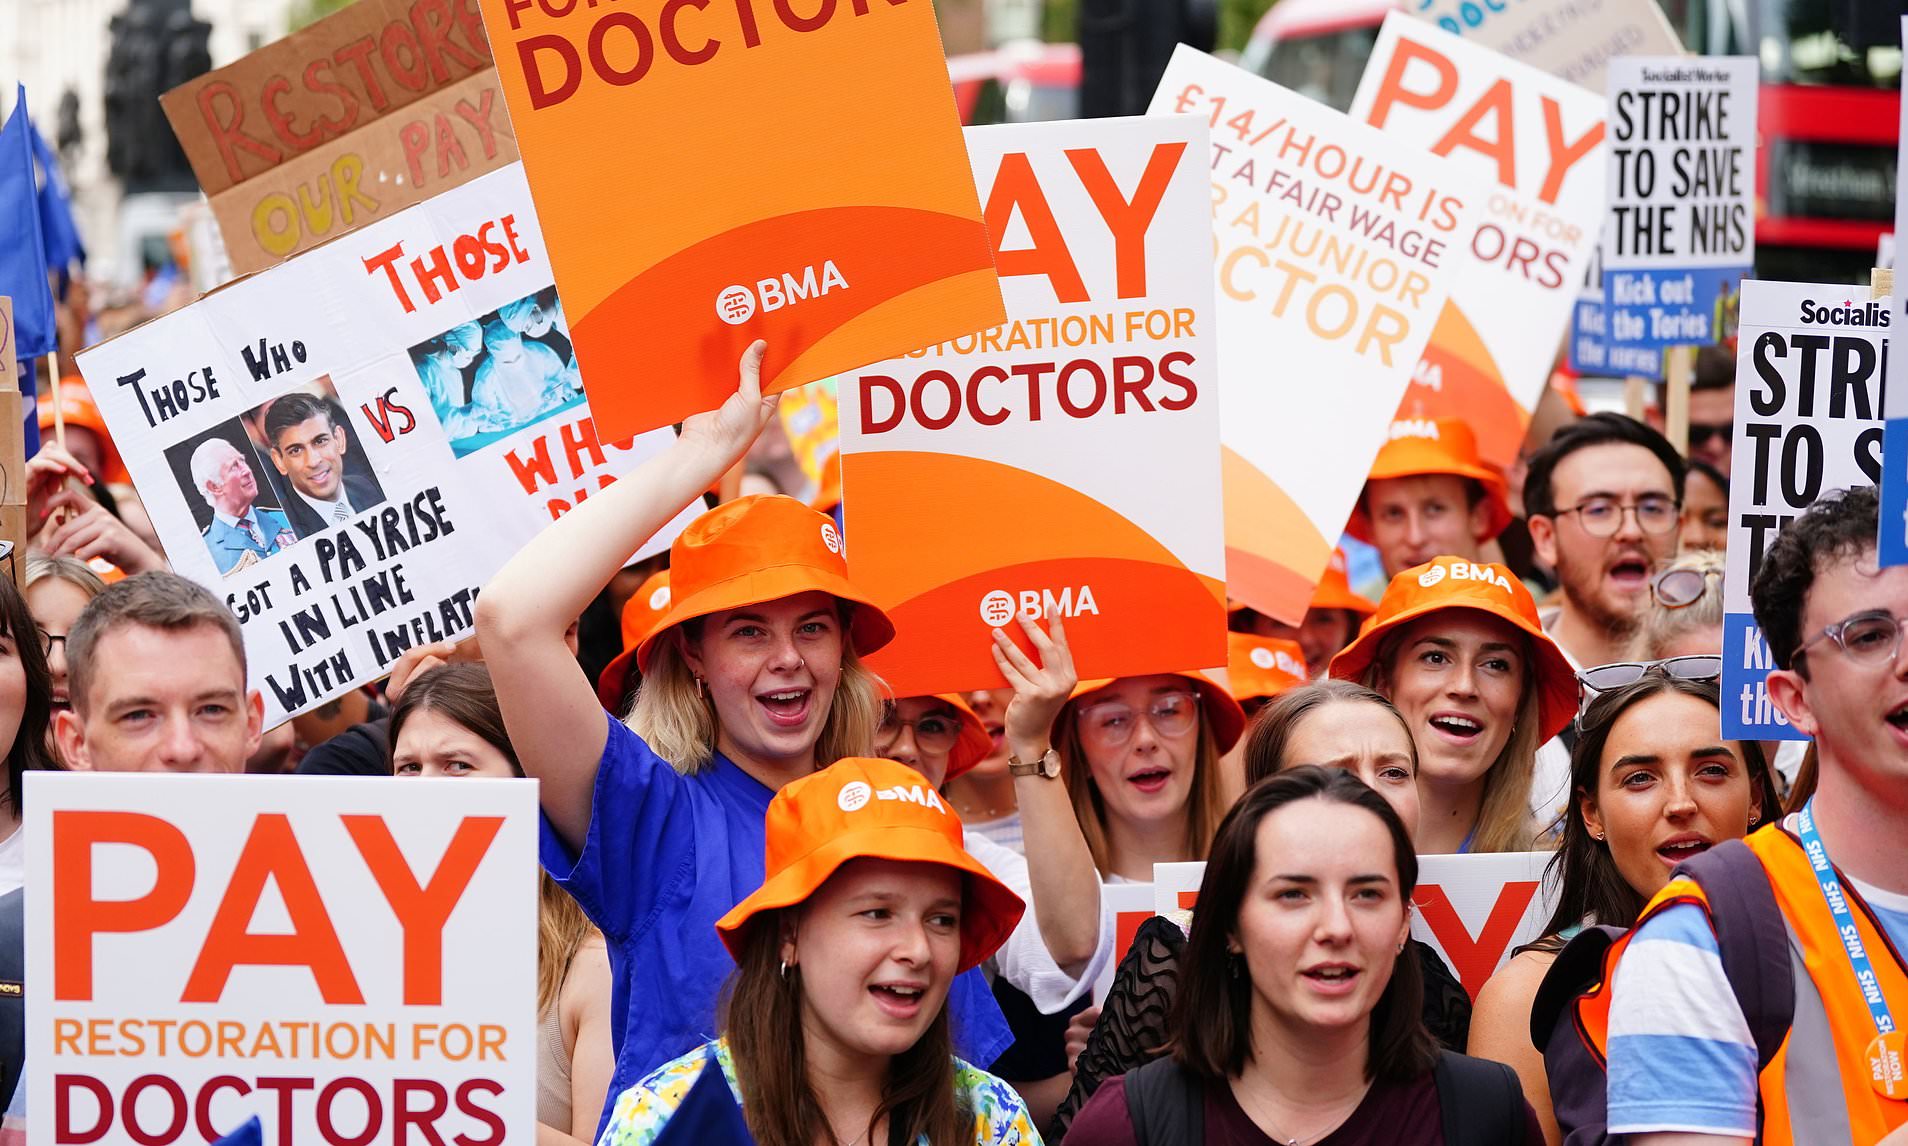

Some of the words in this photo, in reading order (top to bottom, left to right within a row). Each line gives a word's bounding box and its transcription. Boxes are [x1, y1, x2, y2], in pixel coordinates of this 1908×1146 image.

[1366, 36, 1606, 206] PAY
[1615, 91, 1731, 141] STRIKE
[251, 152, 380, 257] OUR
[400, 88, 498, 189] PAY
[1174, 84, 1413, 212] £14/HOUR
[1418, 190, 1464, 233] IS
[1614, 149, 1656, 199] TO
[1672, 148, 1742, 199] SAVE
[983, 141, 1188, 303] AY
[1232, 158, 1256, 187] A
[1265, 170, 1342, 222] FAIR
[1349, 204, 1447, 268] WAGE
[1612, 206, 1676, 256] THE
[1691, 203, 1747, 253] NHS
[362, 214, 530, 314] THOSE
[1231, 201, 1261, 237] A
[1264, 215, 1431, 309] JUNIOR
[756, 260, 849, 313] BMA
[1212, 231, 1412, 367] CTOR
[1613, 273, 1656, 305] Kick
[1660, 273, 1694, 304] out
[1800, 299, 1891, 328] Socialis
[1126, 308, 1196, 342] FOR
[1613, 308, 1645, 341] the
[1649, 306, 1708, 340] Tories
[117, 367, 221, 427] THOSE
[241, 337, 308, 382] WHO
[858, 351, 1198, 435] DOCTORS
[361, 387, 417, 444] VS
[503, 417, 634, 495] WH
[1746, 423, 1824, 508] TO
[226, 580, 273, 625] GOT
[289, 563, 312, 596] A
[315, 486, 455, 584] PAYRISE
[1450, 562, 1513, 594] BMA
[278, 603, 331, 655] IN
[331, 563, 415, 629] LINE
[1019, 585, 1099, 621] BMA
[265, 648, 355, 713] WITH
[1806, 839, 1829, 872] NHS
[53, 810, 507, 1006] PAY
[1823, 881, 1847, 915] NHS
[1841, 924, 1865, 959] NHS
[1857, 969, 1882, 1005] NHS
[54, 1018, 395, 1060] RESTORATION
[413, 1023, 508, 1062] FOR
[1870, 1056, 1884, 1081] PAY
[1888, 1050, 1903, 1081] NOW
[55, 1074, 506, 1146] DOCTORS
